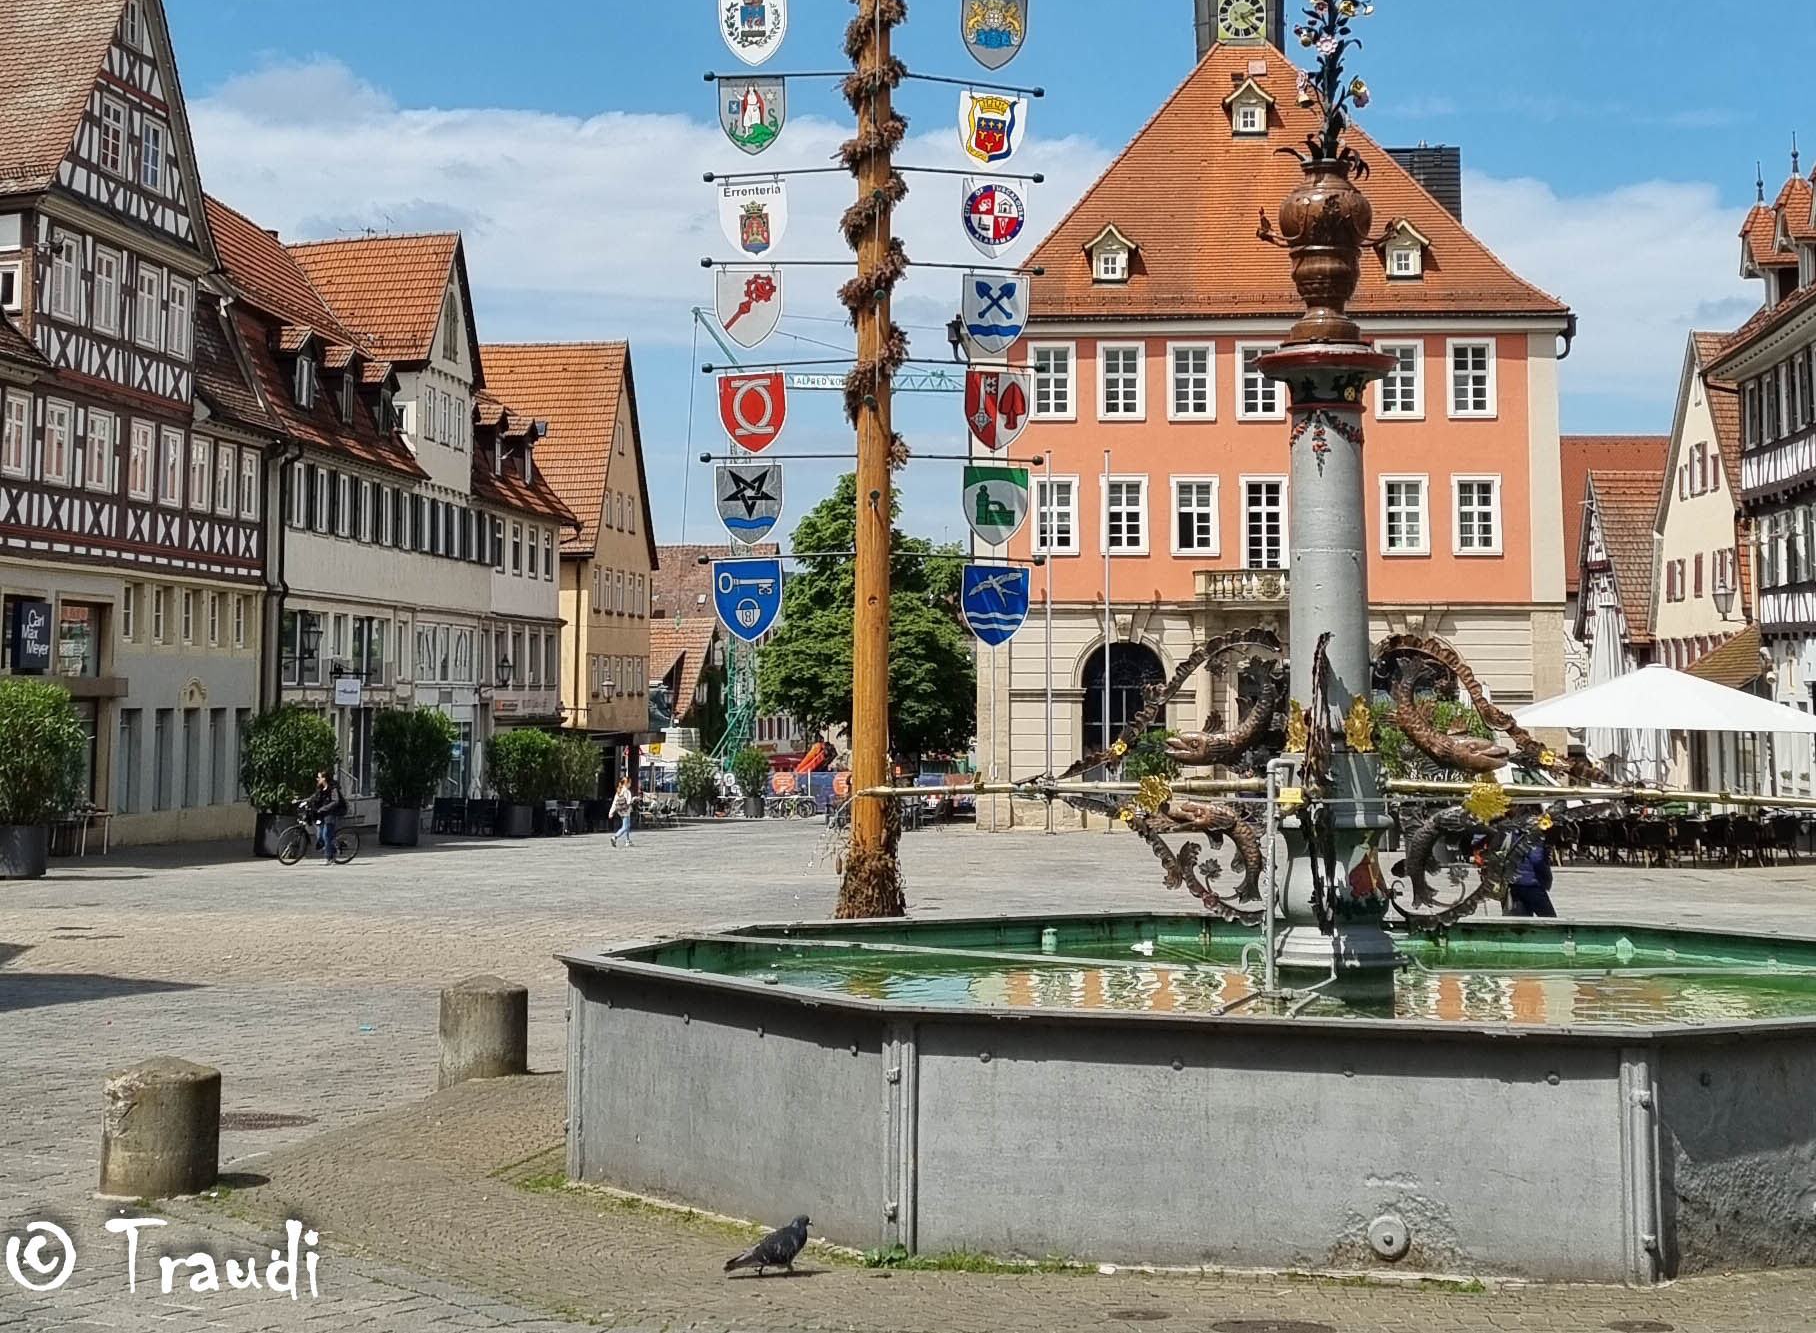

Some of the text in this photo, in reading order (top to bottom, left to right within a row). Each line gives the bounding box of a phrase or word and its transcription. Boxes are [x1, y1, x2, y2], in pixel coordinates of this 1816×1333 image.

[28, 609, 45, 628] Carl
[21, 624, 39, 640] Max
[26, 639, 50, 658] Meyer
